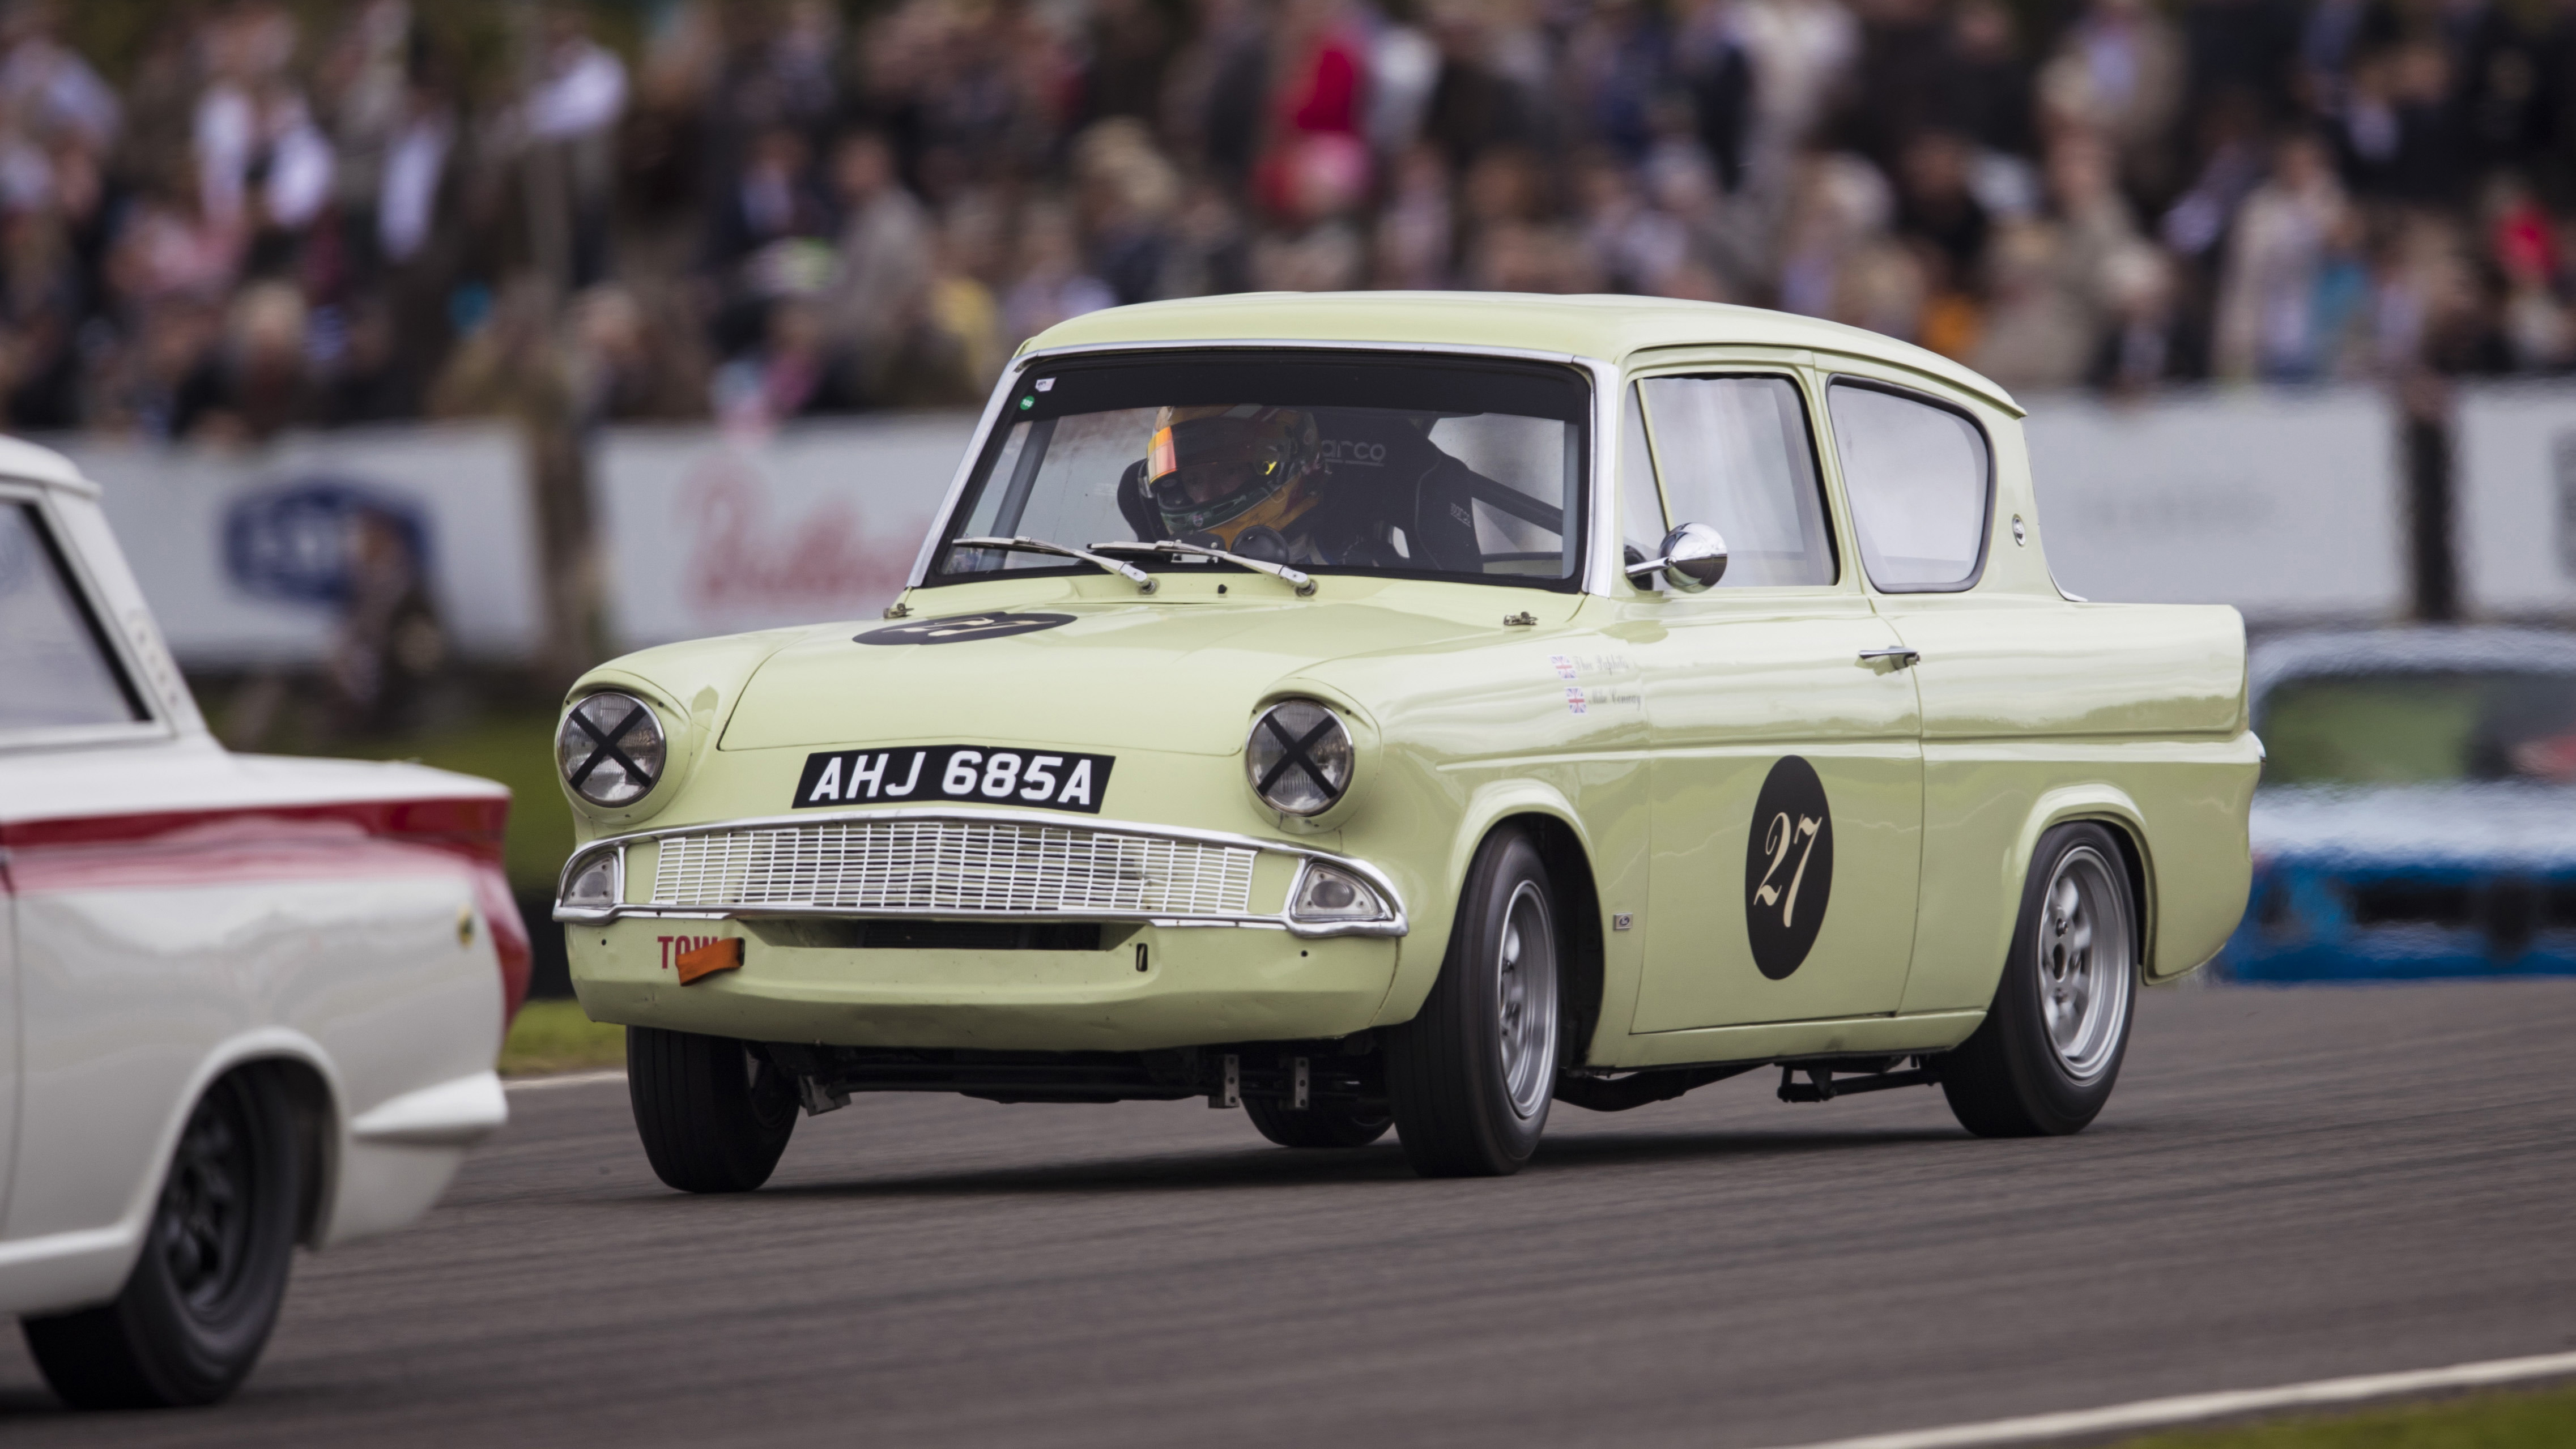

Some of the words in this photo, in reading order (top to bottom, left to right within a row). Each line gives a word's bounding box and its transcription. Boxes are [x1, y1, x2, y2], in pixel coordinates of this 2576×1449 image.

[1321, 439, 1386, 462] arco
[808, 752, 926, 802] AHJ
[942, 751, 1092, 805] 685A
[1753, 812, 1823, 928] 27
